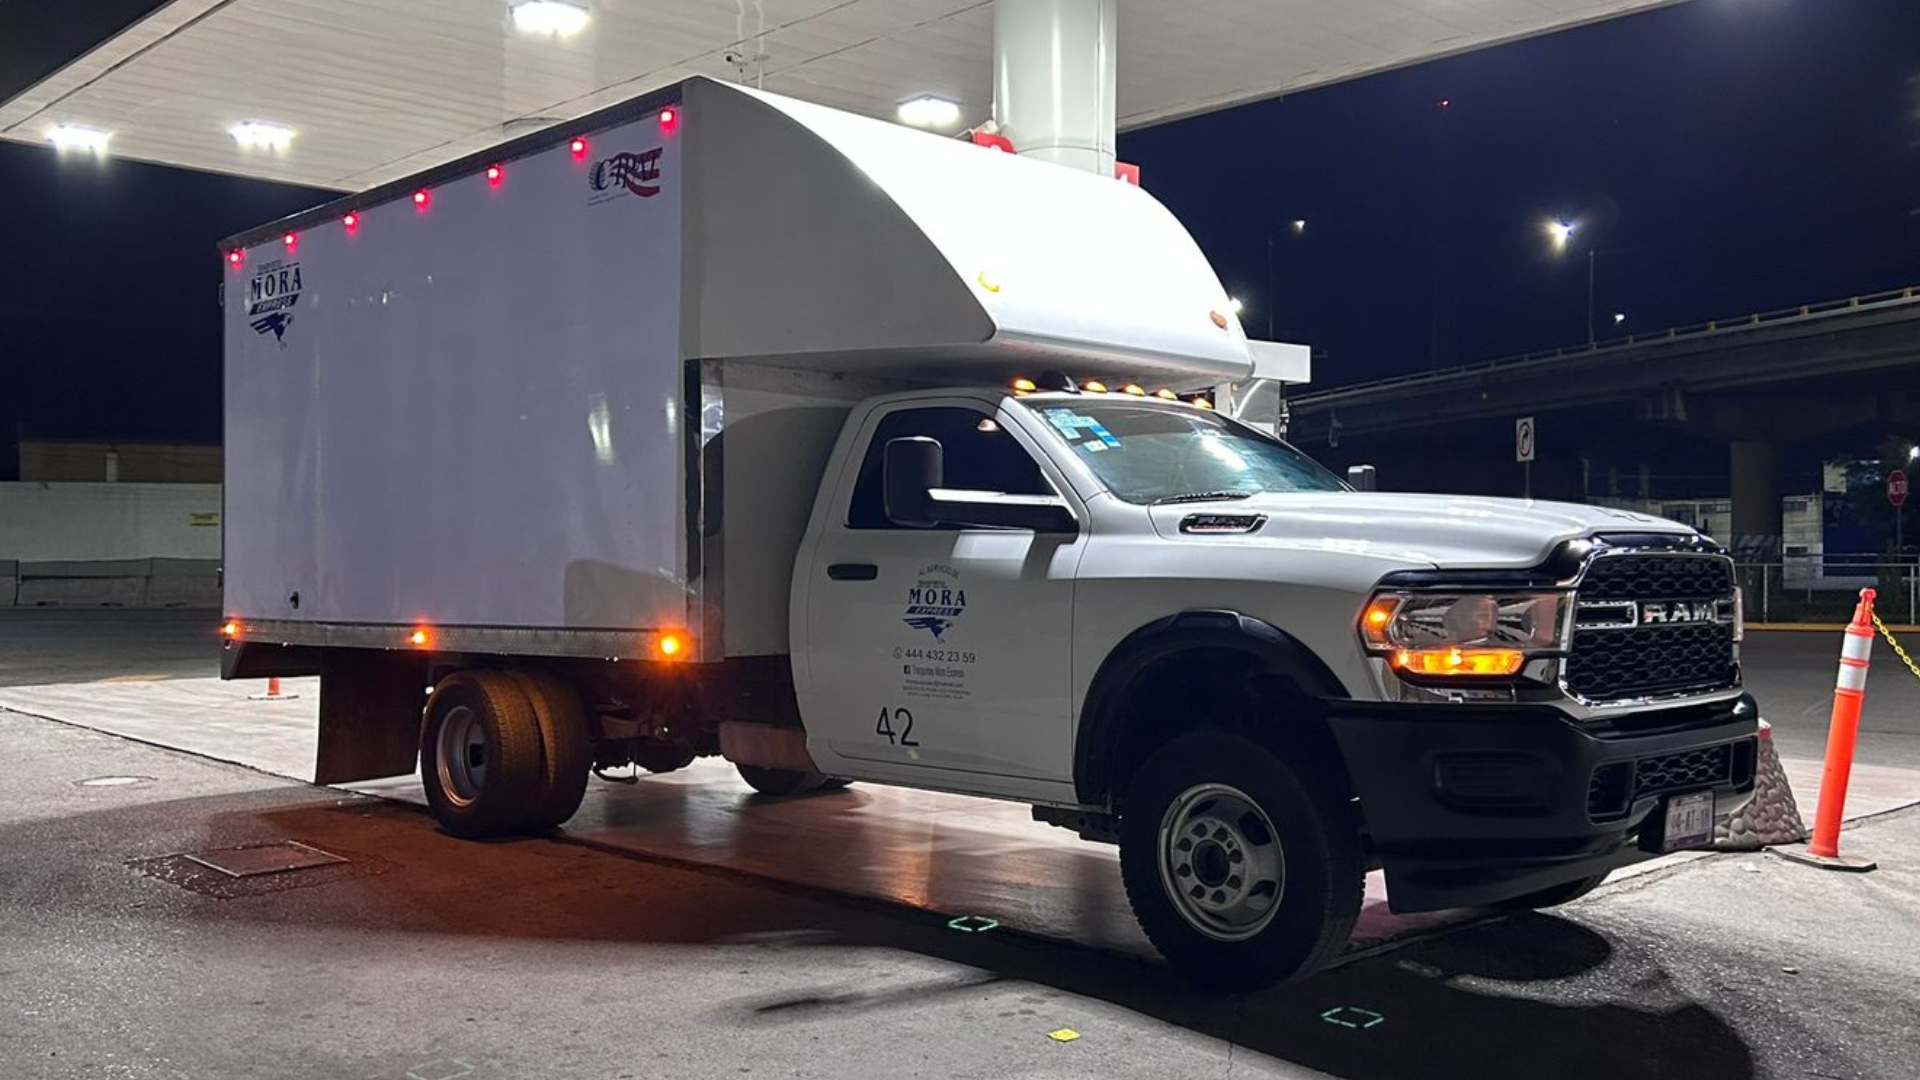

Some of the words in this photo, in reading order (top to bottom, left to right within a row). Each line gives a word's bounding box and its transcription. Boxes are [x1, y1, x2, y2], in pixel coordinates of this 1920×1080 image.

[250, 267, 302, 302] MORA
[907, 588, 967, 607] MORA
[1643, 602, 1717, 623] RAM
[904, 648, 924, 658] 444
[925, 649, 945, 661] 432
[946, 650, 961, 662] 23
[962, 652, 976, 663] 59
[876, 706, 919, 746] 42
